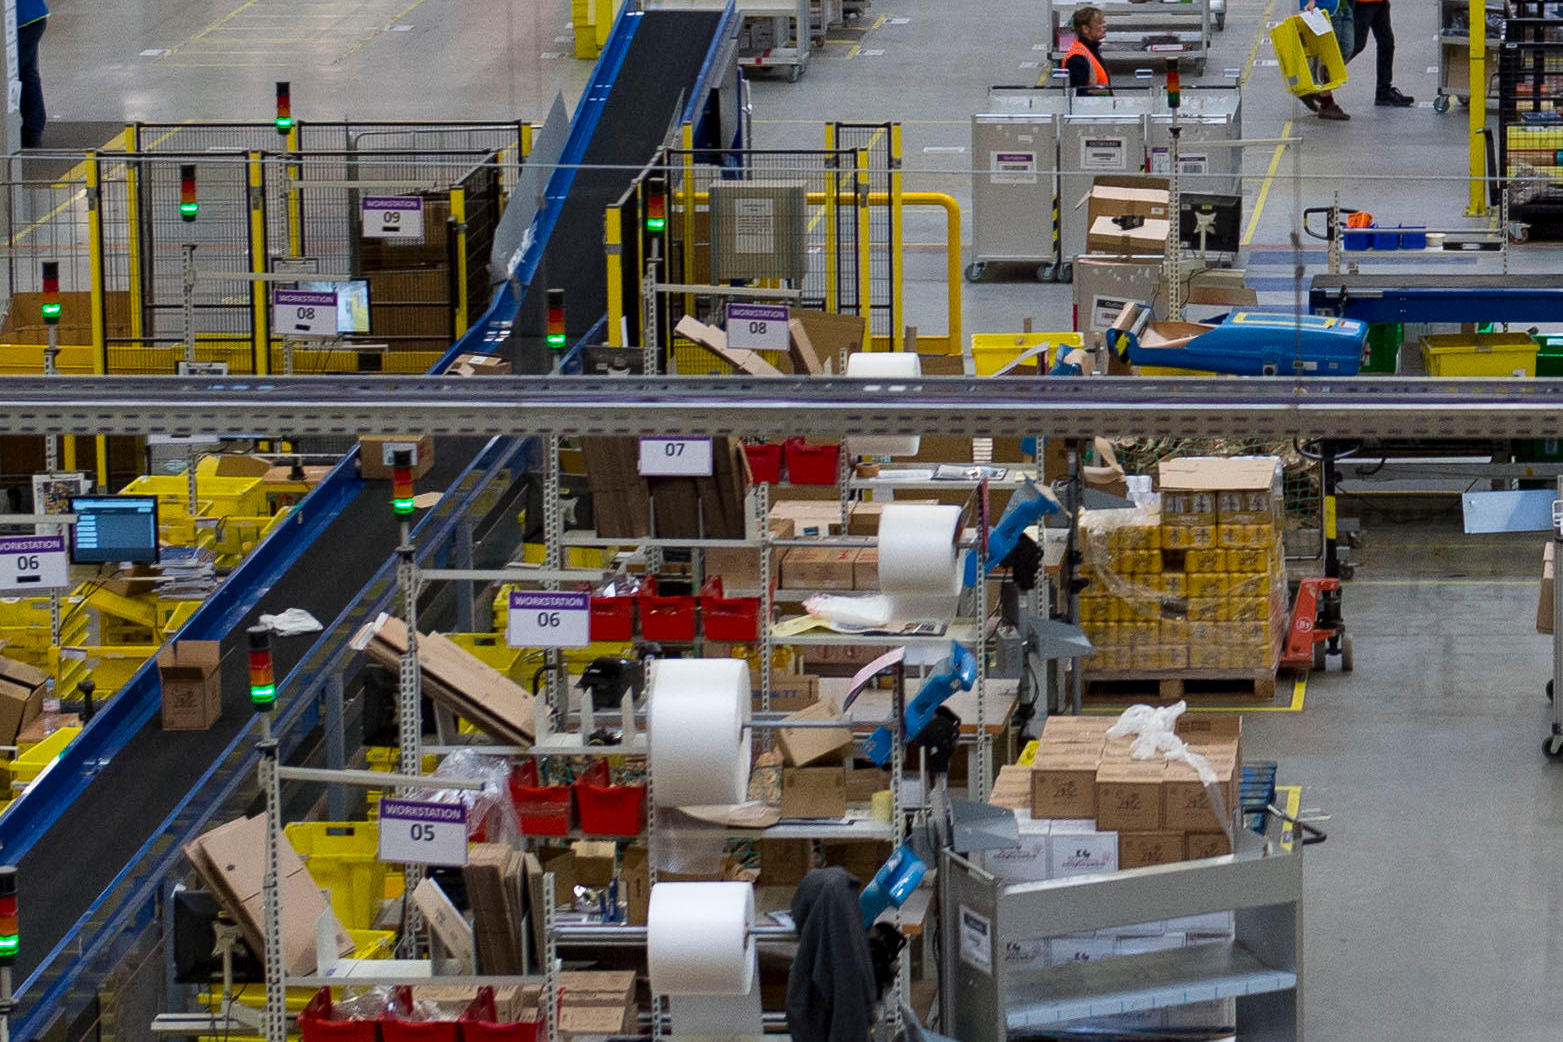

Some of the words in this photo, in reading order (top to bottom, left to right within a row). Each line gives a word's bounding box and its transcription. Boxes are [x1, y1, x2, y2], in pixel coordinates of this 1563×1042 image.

[366, 200, 417, 208] WORKSTATION
[383, 211, 400, 224] 09
[278, 294, 334, 304] WORKSTATION
[297, 307, 315, 320] 08
[732, 309, 785, 319] WORKSTATION
[749, 321, 767, 334] 08
[664, 442, 685, 457] 07
[17, 555, 40, 571] 06
[513, 595, 585, 607] WORKSTATION
[537, 611, 560, 627] 06
[385, 804, 462, 819] WORKSTATION
[410, 823, 435, 842] 05
